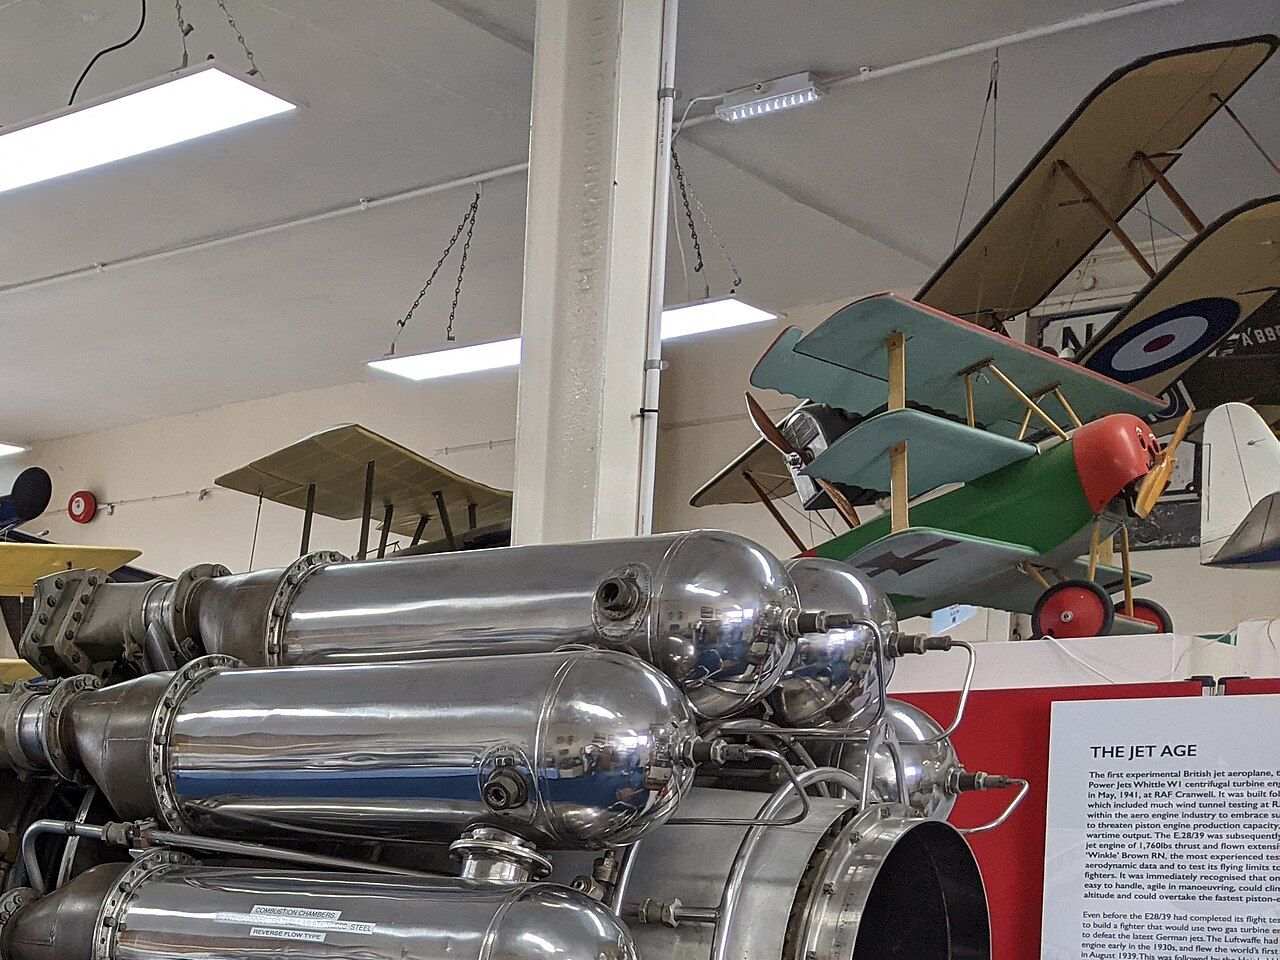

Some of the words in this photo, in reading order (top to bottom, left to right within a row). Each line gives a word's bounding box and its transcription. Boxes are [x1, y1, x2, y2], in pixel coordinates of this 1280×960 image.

[1090, 746, 1124, 758] THE
[1128, 745, 1156, 761] JET
[1161, 745, 1197, 757] AGE
[1126, 771, 1180, 779] experimental
[1213, 770, 1225, 778] jet
[1228, 770, 1274, 778] aeroplane,
[1116, 781, 1132, 789] Jets
[1185, 781, 1230, 789] centrifugal
[1098, 792, 1116, 800] May,
[1120, 791, 1141, 799] 1941,
[1228, 801, 1258, 810] testing
[1152, 812, 1179, 820] engine
[1182, 812, 1216, 820] industry
[255, 906, 298, 916] COMBUSTION
[350, 924, 372, 932] STEEL
[253, 929, 283, 937] REVERSE
[304, 932, 321, 940] TYPE
